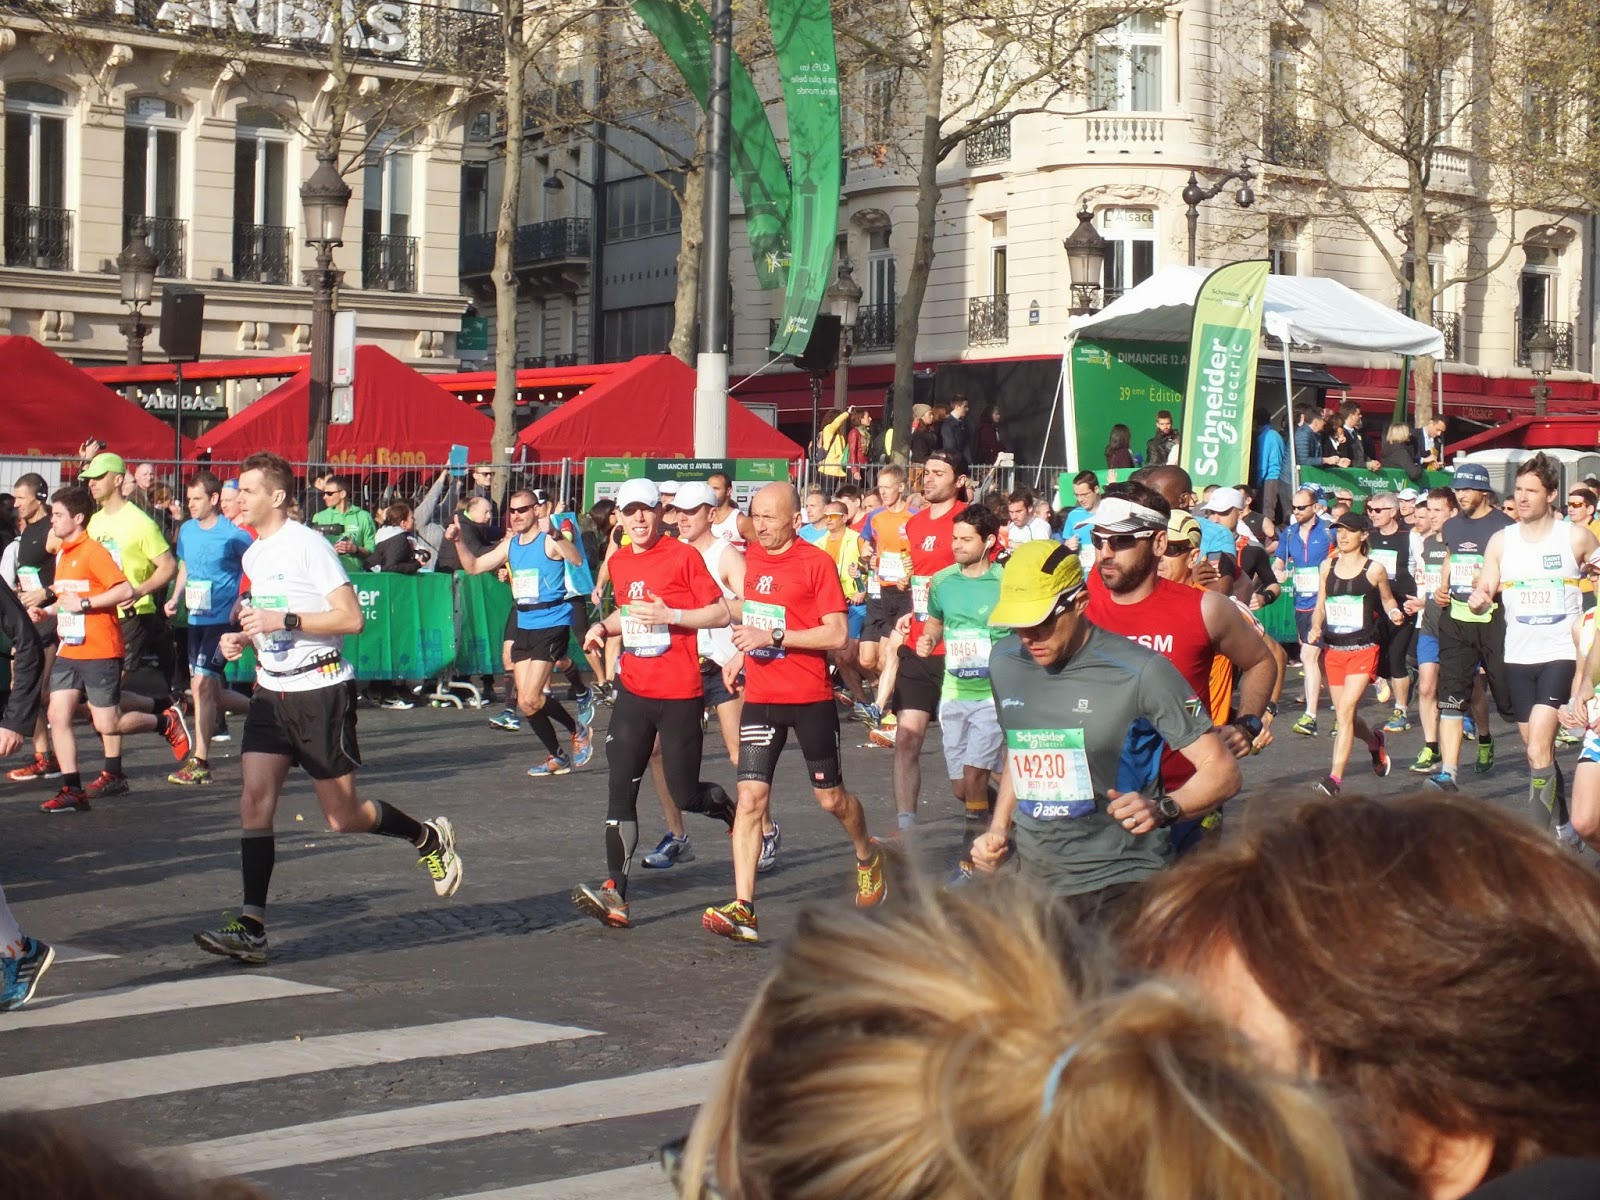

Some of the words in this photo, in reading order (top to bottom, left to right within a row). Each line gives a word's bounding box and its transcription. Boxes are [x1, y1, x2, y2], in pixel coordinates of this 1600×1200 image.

[1118, 352, 1168, 365] DIMANCHE
[1170, 355, 1179, 365] 12
[1222, 343, 1243, 419] Electric
[1119, 387, 1131, 401] 39
[1149, 384, 1184, 402] Éditio
[1195, 338, 1228, 476] Schneider
[1358, 476, 1390, 488] Schneider
[1429, 551, 1448, 559] NIGE
[1520, 590, 1551, 605] 21232
[1016, 731, 1066, 743] Schneider
[1013, 753, 1066, 779] 14230
[1042, 805, 1070, 816] asics
